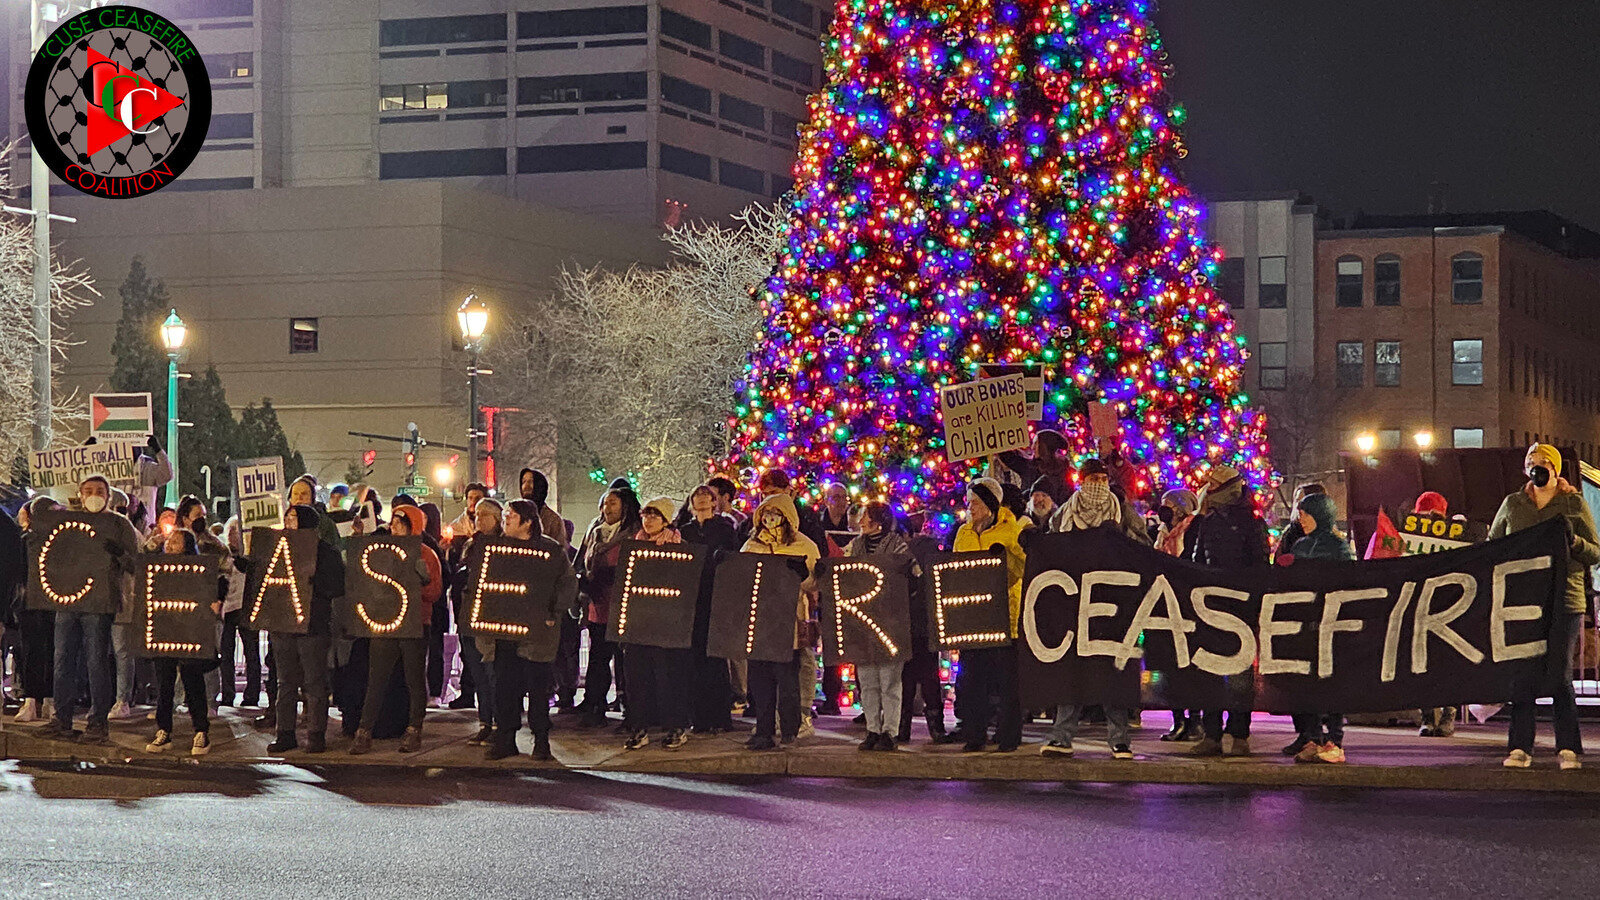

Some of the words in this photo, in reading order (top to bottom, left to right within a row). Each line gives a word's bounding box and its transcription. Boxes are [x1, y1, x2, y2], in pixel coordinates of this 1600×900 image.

[946, 387, 976, 409] OUR
[978, 377, 1024, 401] BOMBS
[951, 414, 972, 428] are
[951, 424, 1025, 457] Children
[34, 448, 91, 469] JUSTICE
[92, 450, 107, 463] FOR
[108, 442, 131, 462] ALL
[31, 470, 55, 488] END
[56, 471, 70, 485] THE
[243, 469, 276, 494] שלום
[245, 501, 279, 523] سلام
[1404, 515, 1463, 539] STOP
[1023, 555, 1551, 682] CEASEFIRE
